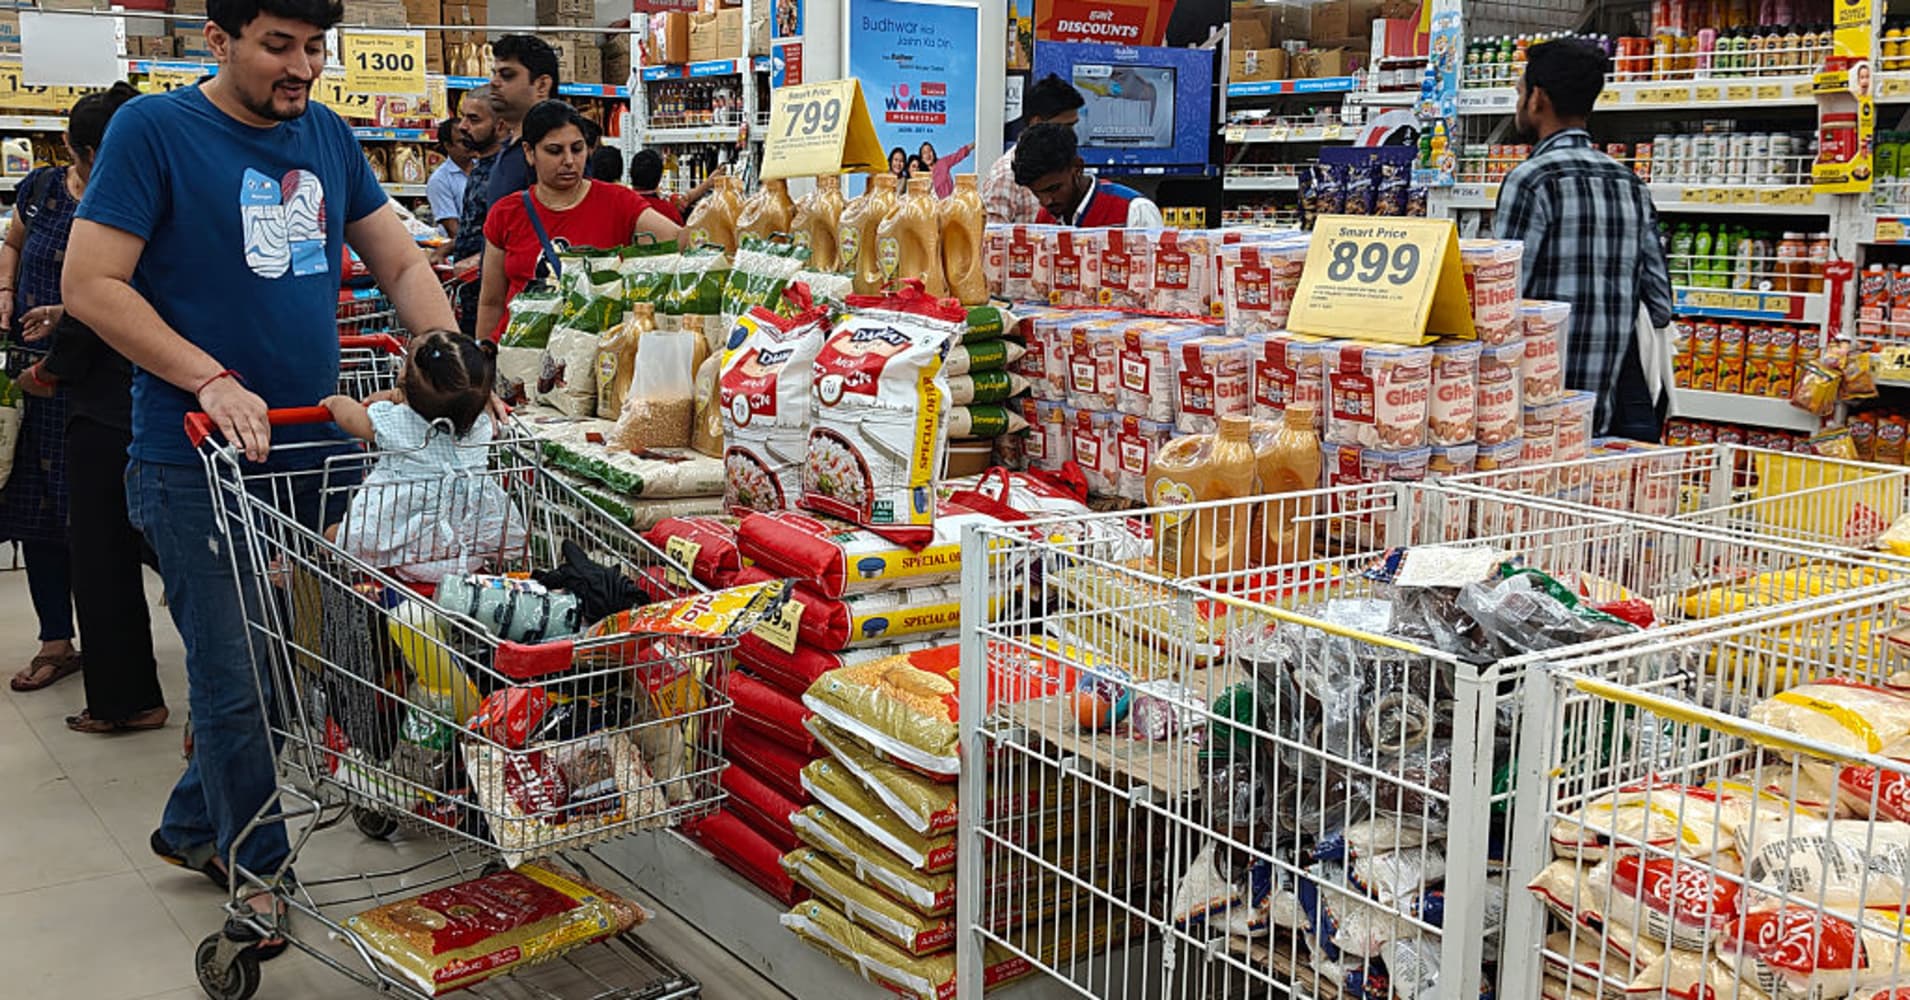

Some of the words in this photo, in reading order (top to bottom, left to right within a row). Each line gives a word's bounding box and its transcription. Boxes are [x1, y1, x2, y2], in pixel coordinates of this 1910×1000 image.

[863, 16, 918, 34] Budhwar
[1057, 20, 1139, 38] DISCOUNTS
[356, 52, 414, 71] 1300
[785, 98, 841, 137] 799
[1339, 227, 1374, 238] Smart
[1376, 227, 1407, 239] Price
[1327, 240, 1420, 285] 899
[1386, 387, 1428, 406] Ghee
[920, 418, 933, 470] SPECIAL
[902, 554, 948, 568] SPECIAL
[903, 614, 945, 627] SPECIAL
